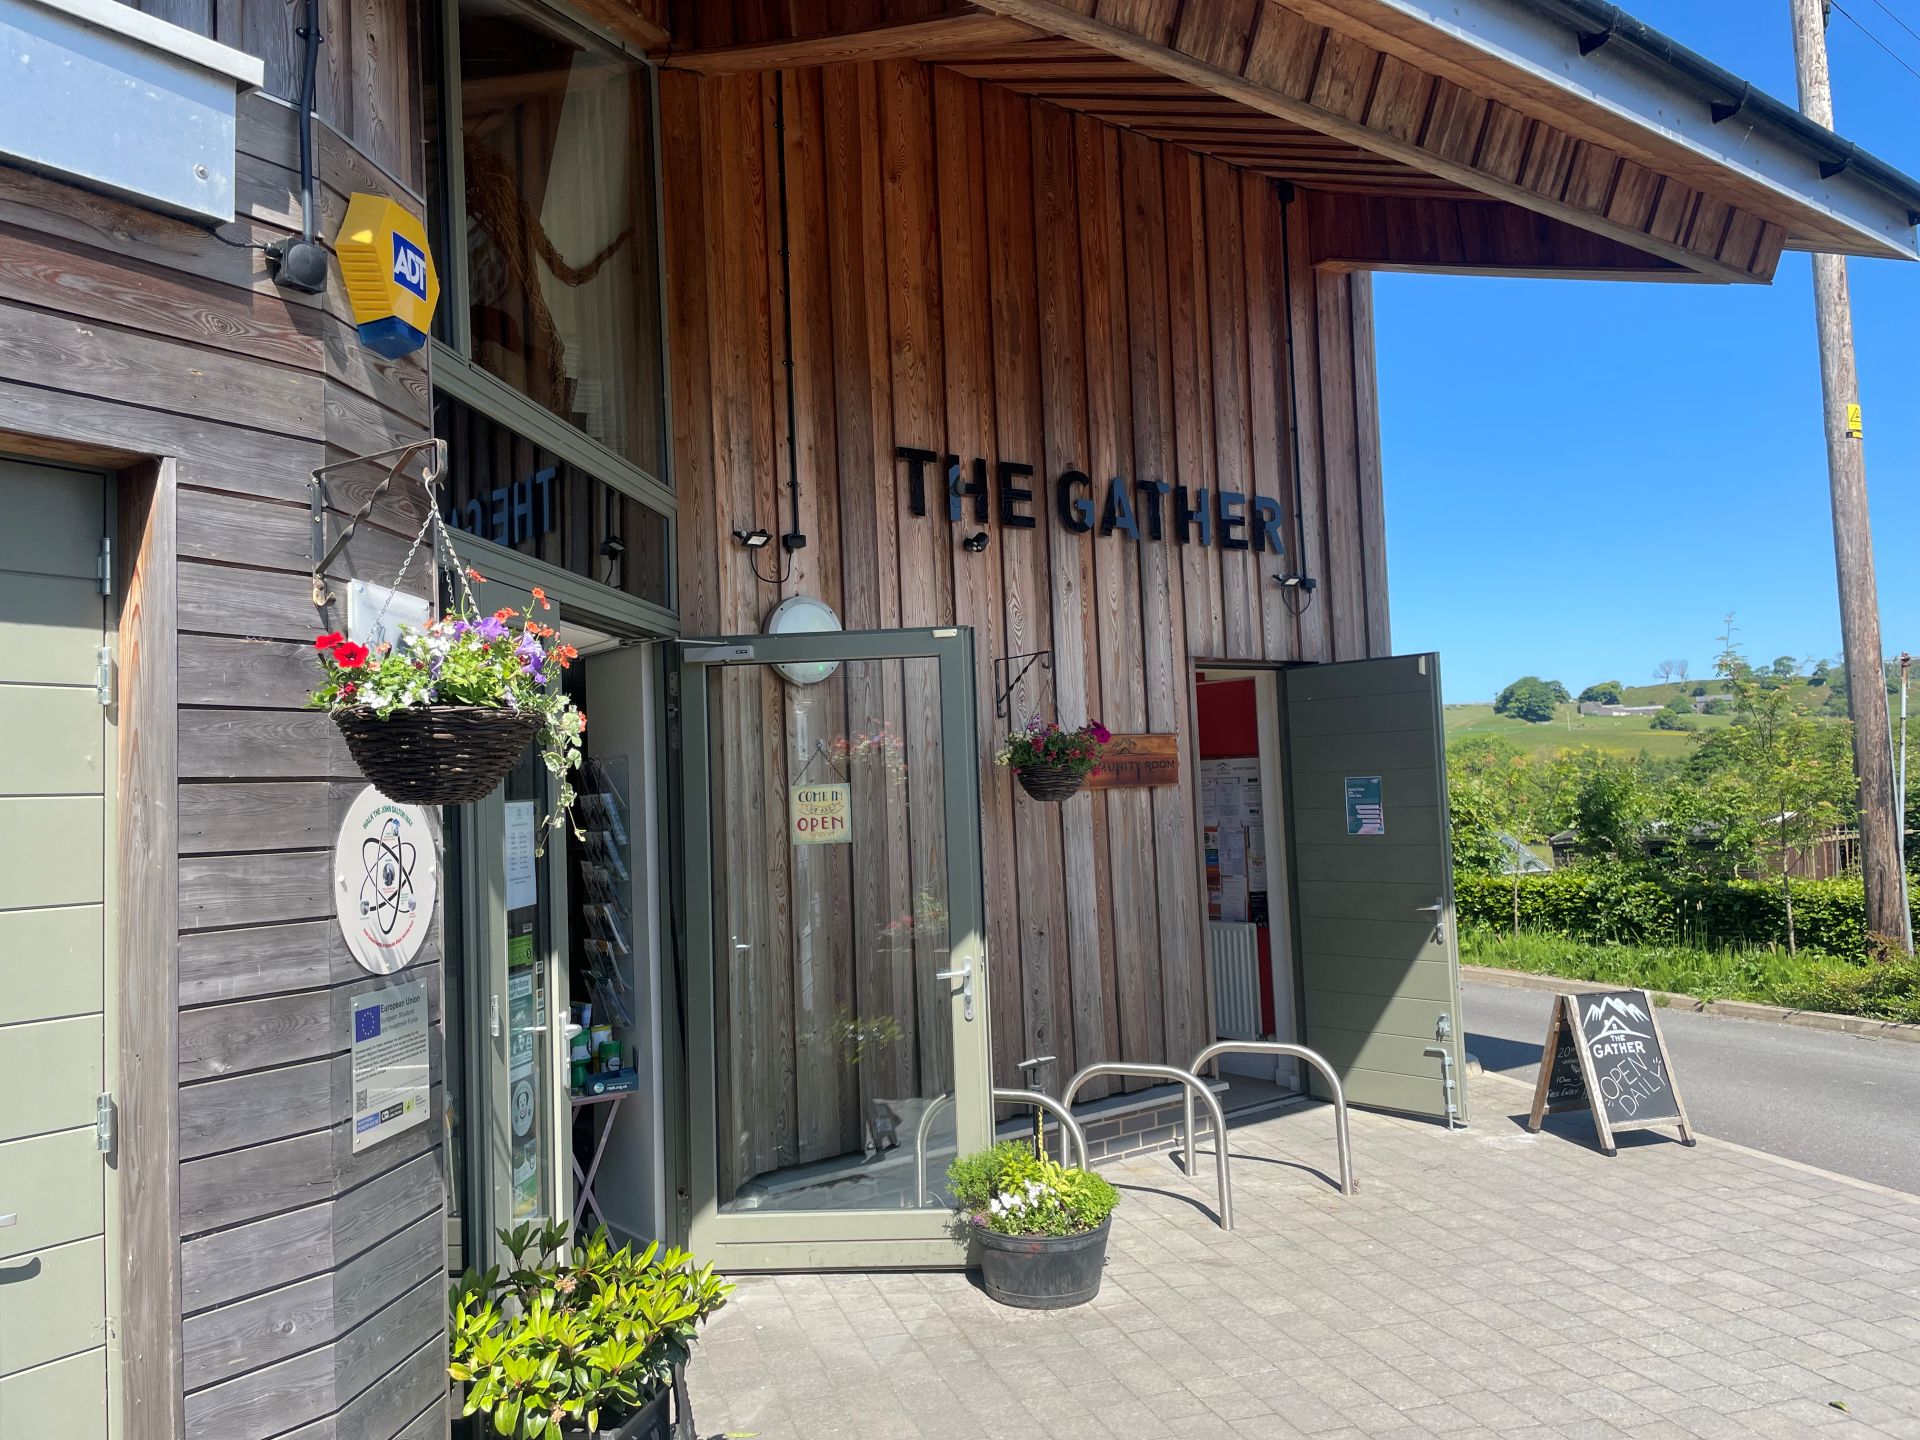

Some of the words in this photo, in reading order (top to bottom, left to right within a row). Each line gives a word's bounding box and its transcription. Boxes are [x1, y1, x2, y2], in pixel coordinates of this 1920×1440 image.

[394, 245, 426, 291] ADT
[896, 446, 1036, 528] THE
[1057, 470, 1286, 555] GATHER
[1144, 759, 1175, 770] ROOM
[798, 791, 828, 802] COME
[831, 790, 843, 801] IN
[362, 813, 374, 829] WALK
[373, 807, 381, 817] THE
[797, 816, 844, 832] OPEN
[380, 1000, 405, 1013] European
[405, 995, 421, 1006] Union
[1609, 1034, 1626, 1042] THE
[1592, 1040, 1646, 1059] GATHER
[1600, 1052, 1648, 1100] OPEN
[1618, 1064, 1666, 1116] DAILY
